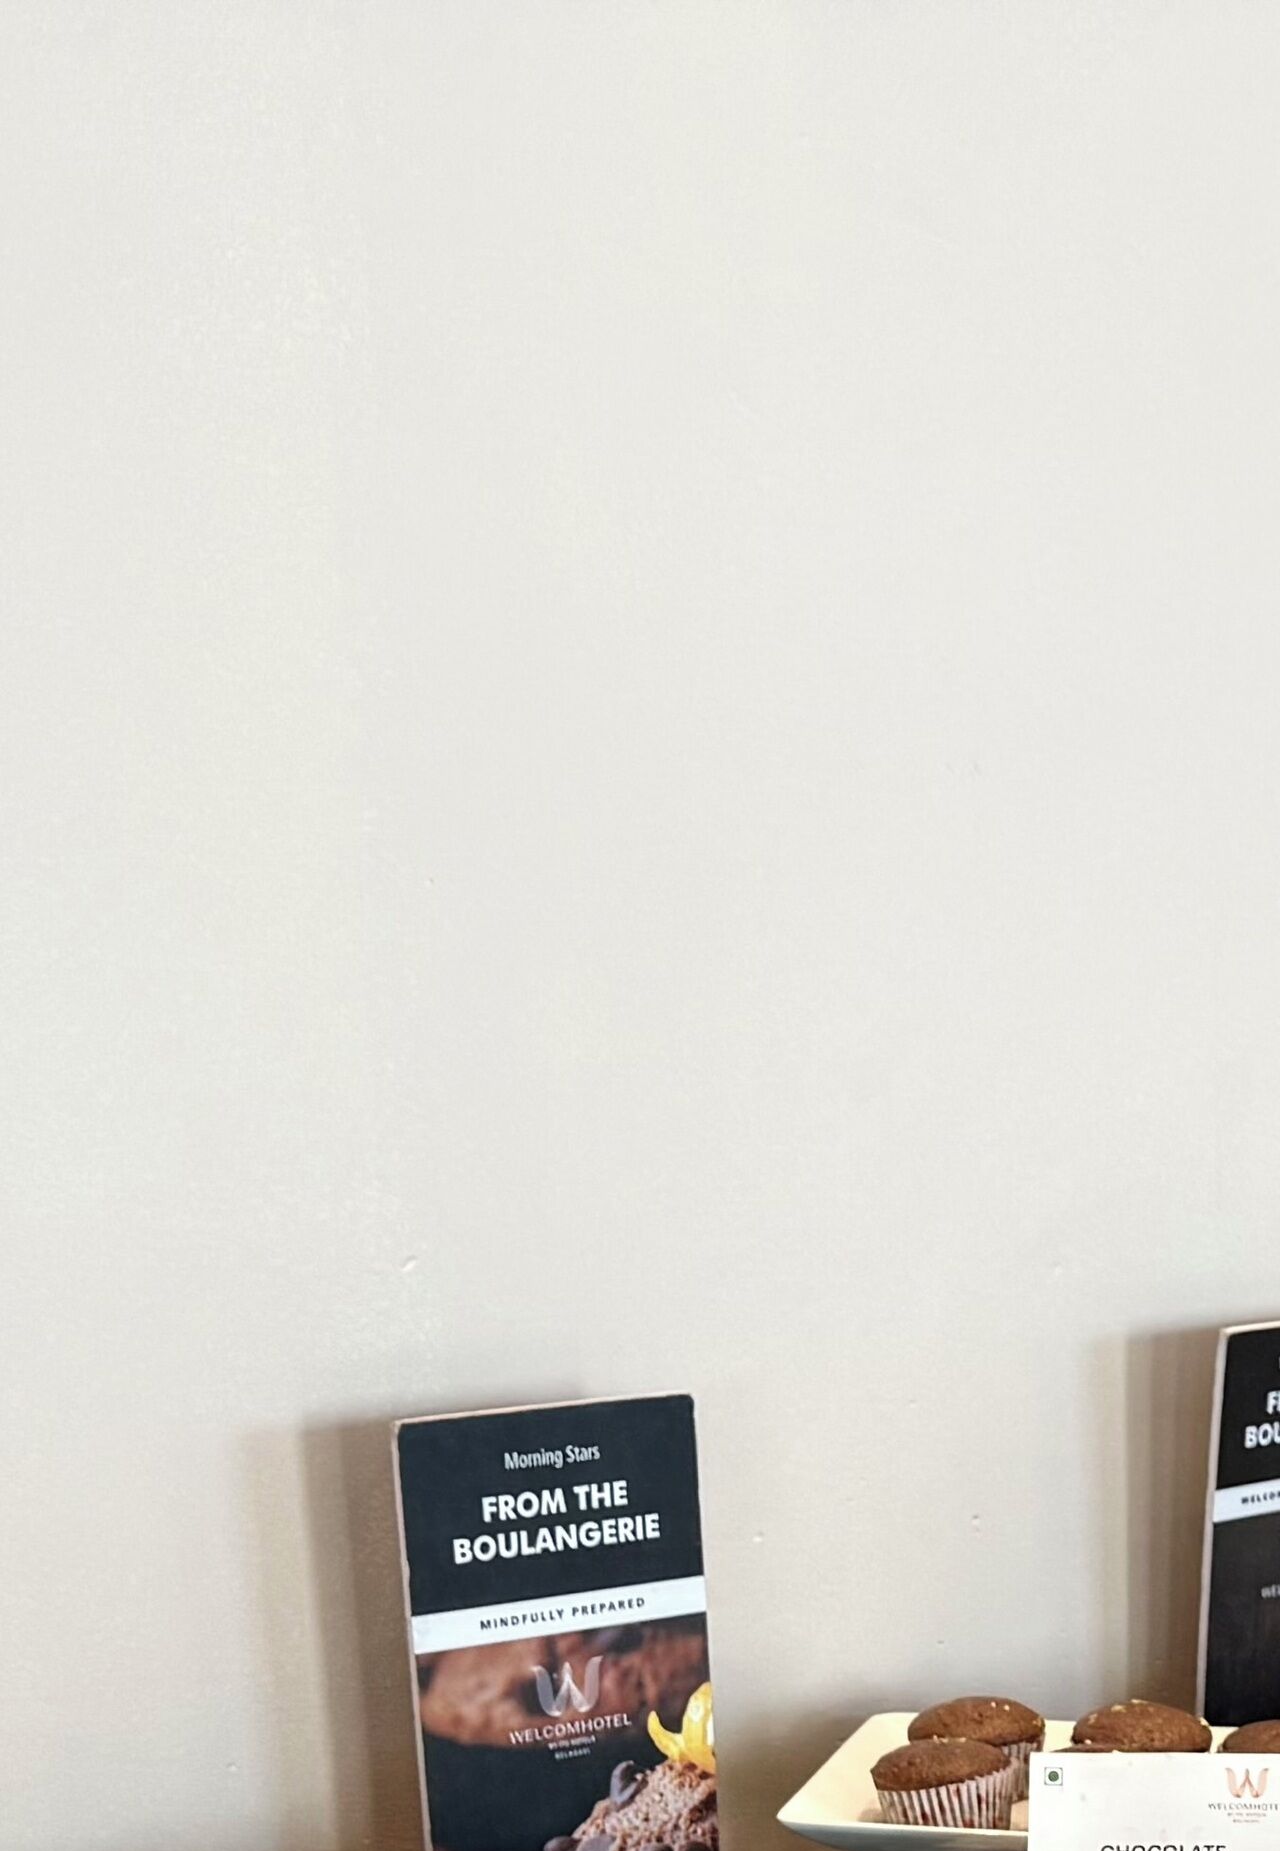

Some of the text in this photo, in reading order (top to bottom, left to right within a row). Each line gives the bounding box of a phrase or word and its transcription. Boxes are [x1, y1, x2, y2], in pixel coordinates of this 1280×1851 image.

[504, 1445, 600, 1470] Morning Stars
[481, 1480, 628, 1523] FROM THE
[452, 1513, 661, 1565] BOULANGERIE
[480, 1597, 645, 1630] MINDFULLY PREPARED
[508, 1712, 632, 1745] WELCOMHOTEL
